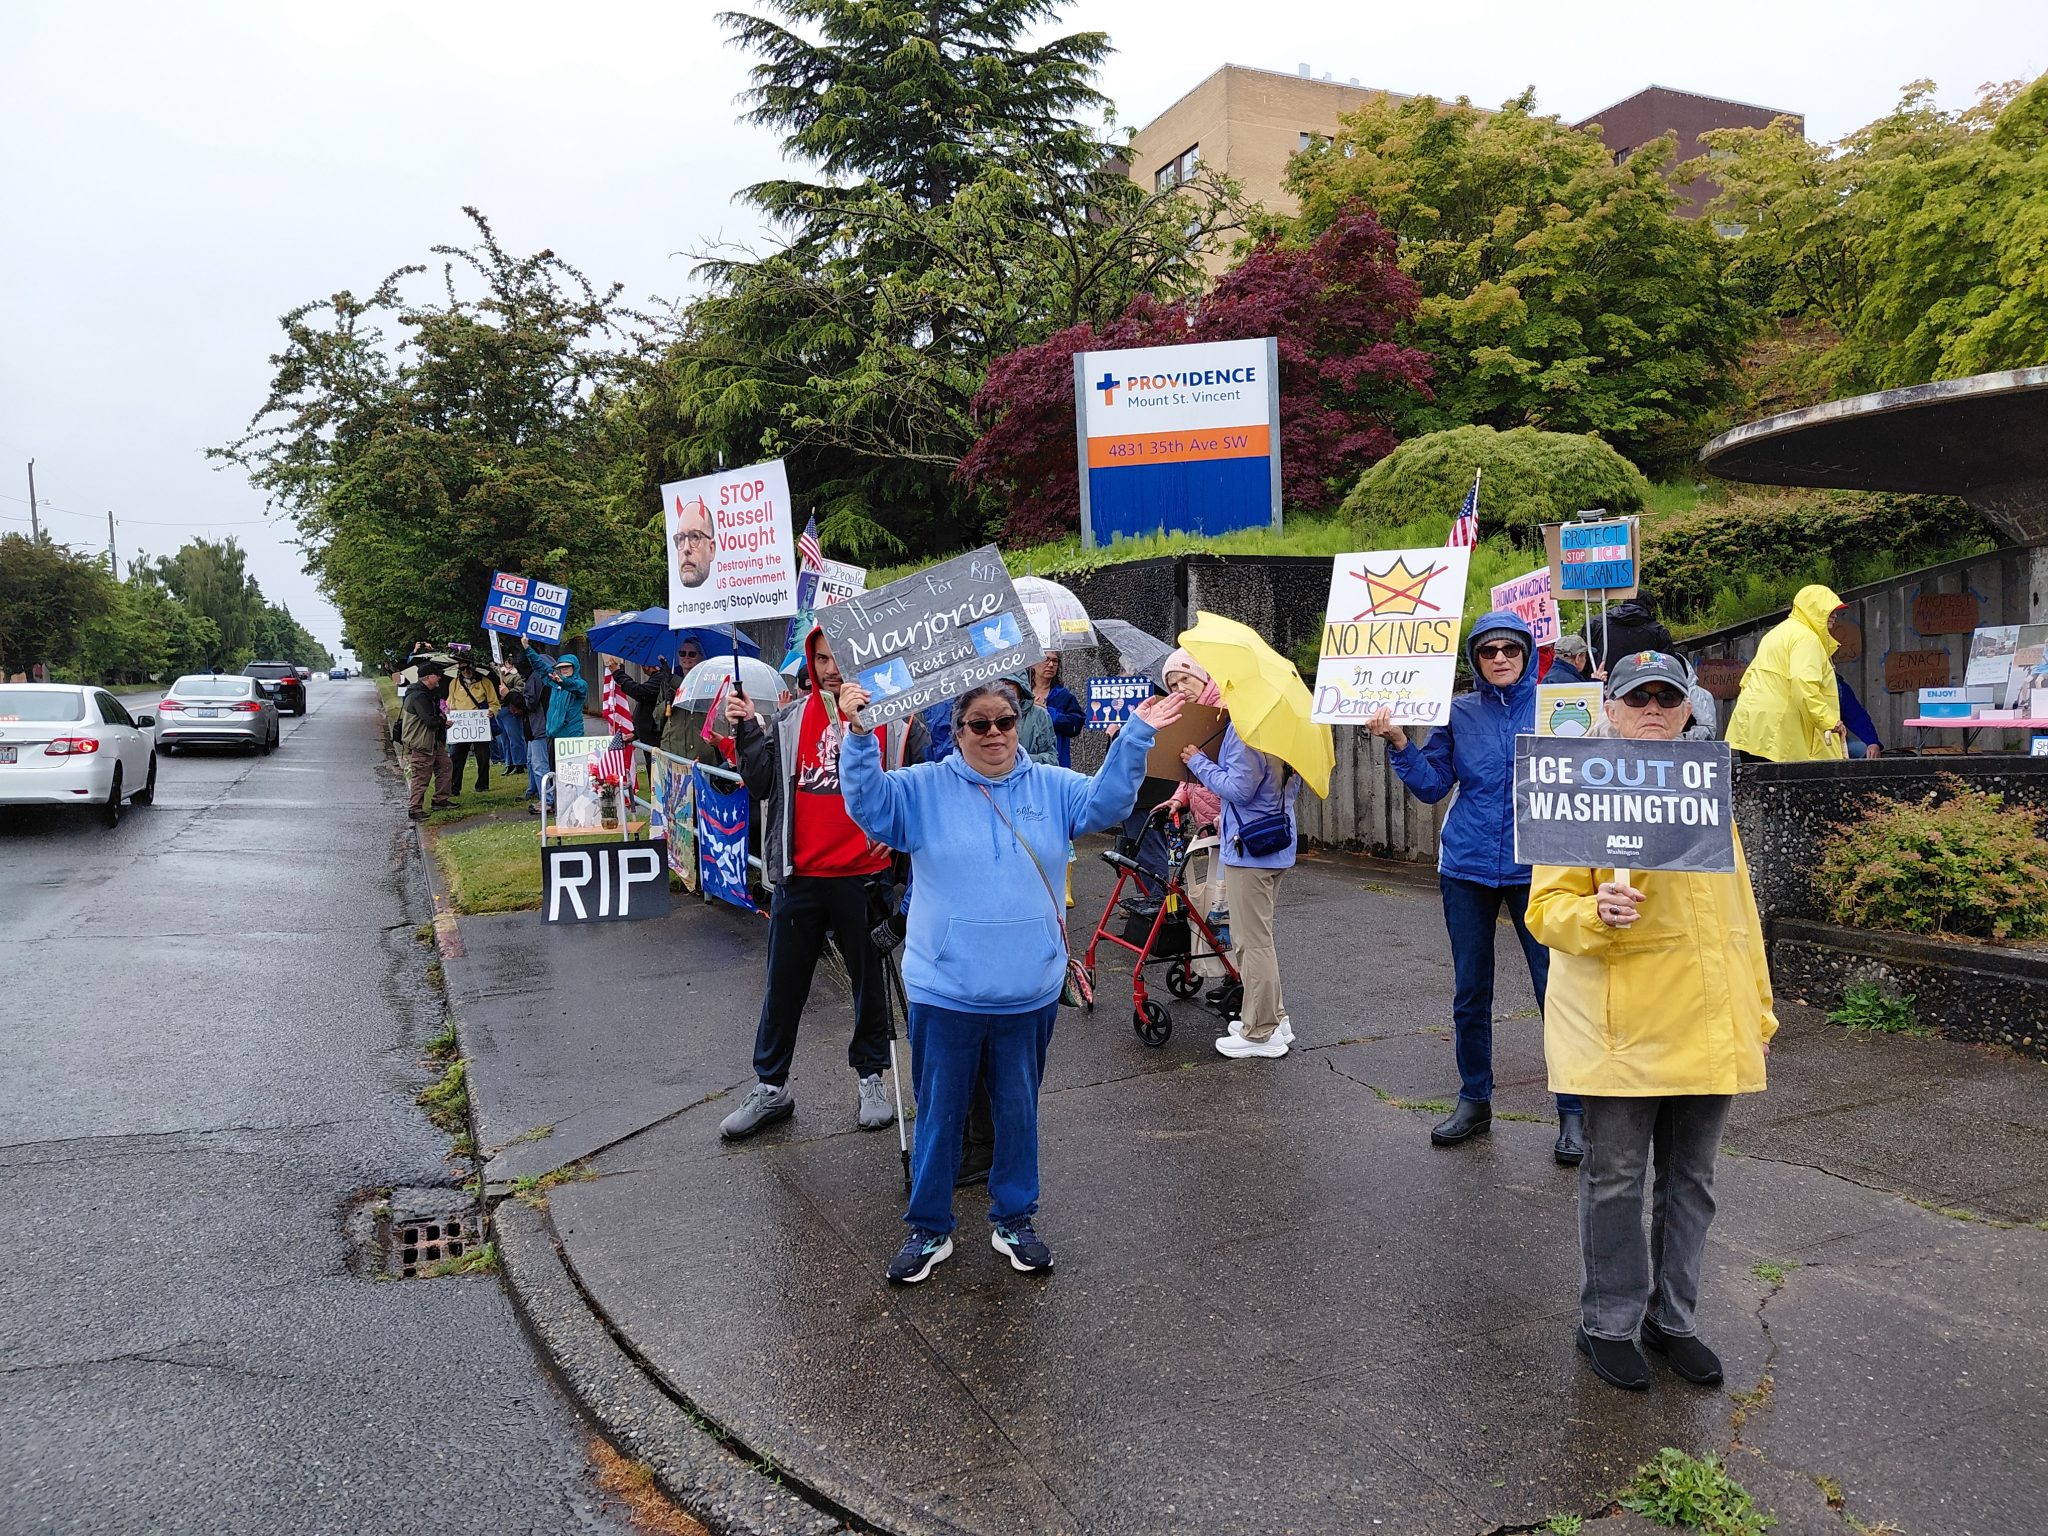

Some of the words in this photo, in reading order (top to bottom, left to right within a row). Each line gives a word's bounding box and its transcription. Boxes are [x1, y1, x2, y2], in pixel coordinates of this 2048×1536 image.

[1128, 367, 1256, 391] PROVIDENCE
[1128, 395, 1169, 408] Mount
[1173, 393, 1189, 405] St.
[1192, 390, 1241, 404] Vincent
[1109, 442, 1143, 457] 4831
[1151, 440, 1184, 454] 35th
[1190, 438, 1218, 452] Ave
[1224, 435, 1248, 449] SW
[720, 480, 765, 506] STOP
[717, 501, 774, 529] Russell
[718, 525, 776, 553] Vought
[1565, 526, 1624, 546] PROTECT
[717, 556, 763, 573] Destroying
[765, 554, 781, 565] the
[1566, 551, 1585, 562] STOP
[1598, 547, 1621, 560] ICE
[717, 577, 727, 590] US
[729, 570, 786, 588] Government
[970, 560, 1001, 582] RIP
[1563, 562, 1630, 587] IMMIGRANTS
[496, 578, 523, 593] ICE
[536, 587, 562, 602] OUT
[822, 581, 853, 598] NEED
[503, 596, 525, 609] FOR
[531, 603, 557, 617] GOOD
[677, 588, 788, 614] change.org/StopVought
[846, 597, 916, 631] Honk
[925, 574, 953, 597] for
[1511, 599, 1538, 622] OVE
[490, 611, 515, 625] ICE
[530, 621, 556, 636] OUT
[826, 614, 844, 639] RIP
[847, 592, 1004, 665] Marjorie
[1325, 623, 1358, 656] NO
[1367, 620, 1451, 655] KINGS
[908, 656, 947, 677] Rest
[951, 644, 973, 660] in
[1898, 652, 1944, 668] ENACT
[869, 687, 935, 723] Power
[940, 677, 956, 695] &
[961, 652, 1026, 688] Peace
[1353, 667, 1373, 686] in
[1381, 670, 1420, 686] our
[1703, 672, 1737, 685] KIDNAP
[1888, 679, 1913, 690] GUN
[1090, 685, 1149, 700] RESIST!
[1927, 690, 1957, 698] ENJOY!
[475, 718, 488, 726] THE
[453, 727, 486, 740] COUP
[559, 740, 583, 756] OUT
[1529, 757, 1573, 785] ICE
[1581, 757, 1674, 788] OUT
[1682, 762, 1718, 789] OF
[1529, 792, 1719, 826] WASHINGTON
[1606, 835, 1644, 849] ACLU
[1606, 849, 1640, 857] Washington
[548, 848, 661, 922] RIP
